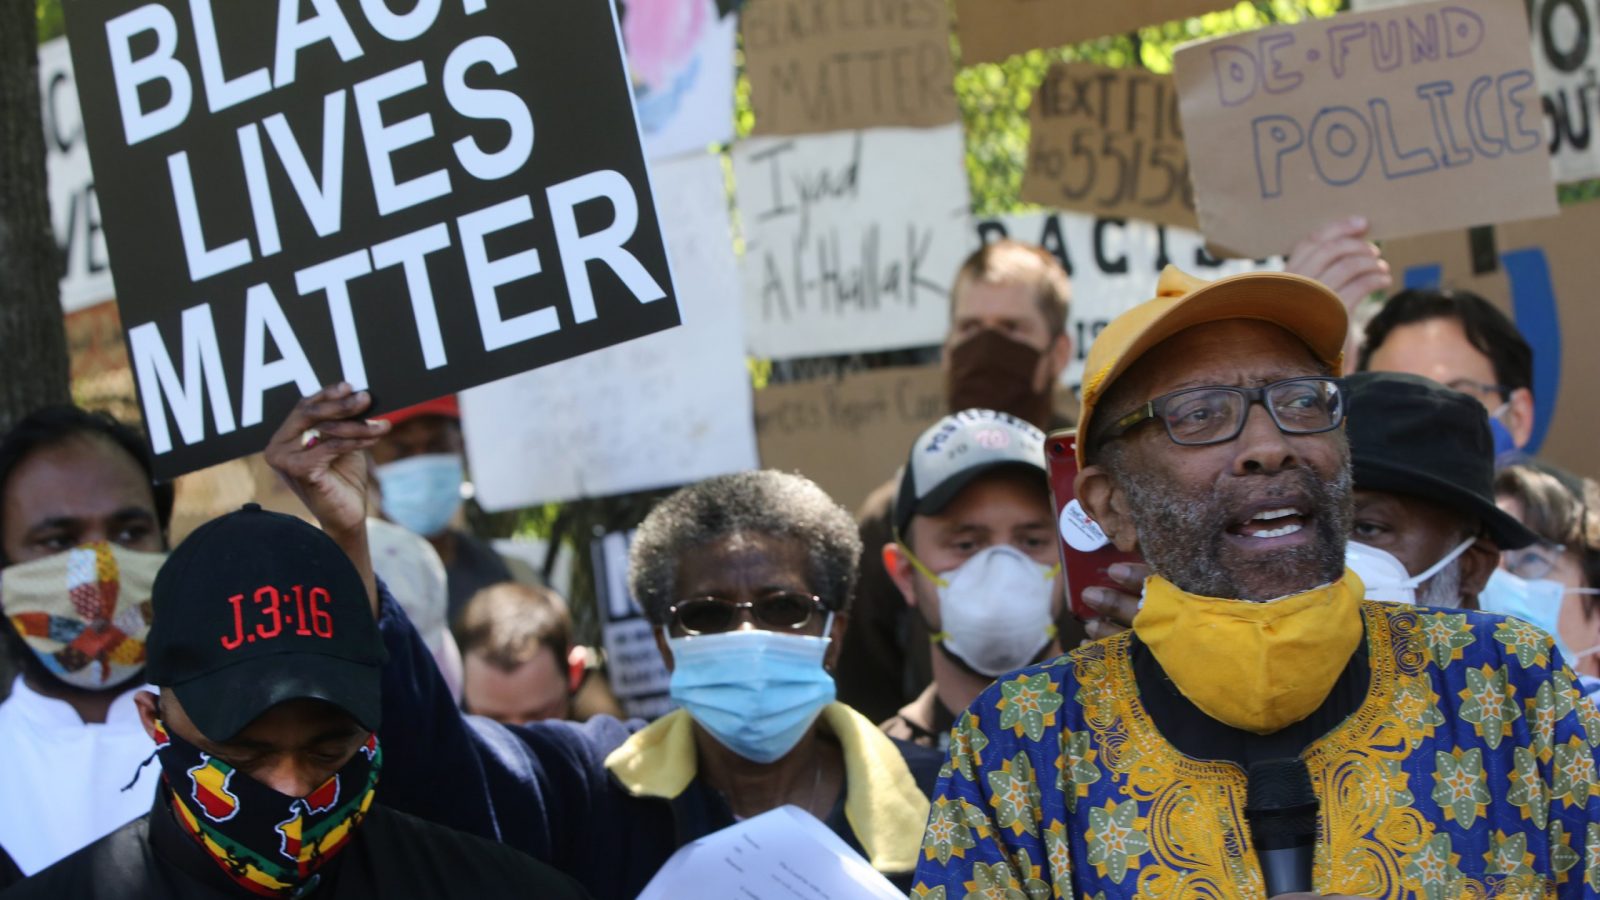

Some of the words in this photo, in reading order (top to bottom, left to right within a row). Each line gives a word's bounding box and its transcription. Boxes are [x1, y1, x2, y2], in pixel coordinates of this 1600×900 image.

[105, 0, 487, 146] BLA
[1252, 69, 1542, 199] POLICE
[167, 35, 535, 283] LIVES
[128, 169, 667, 456] MATTER
[220, 584, 334, 651] J.3:16
